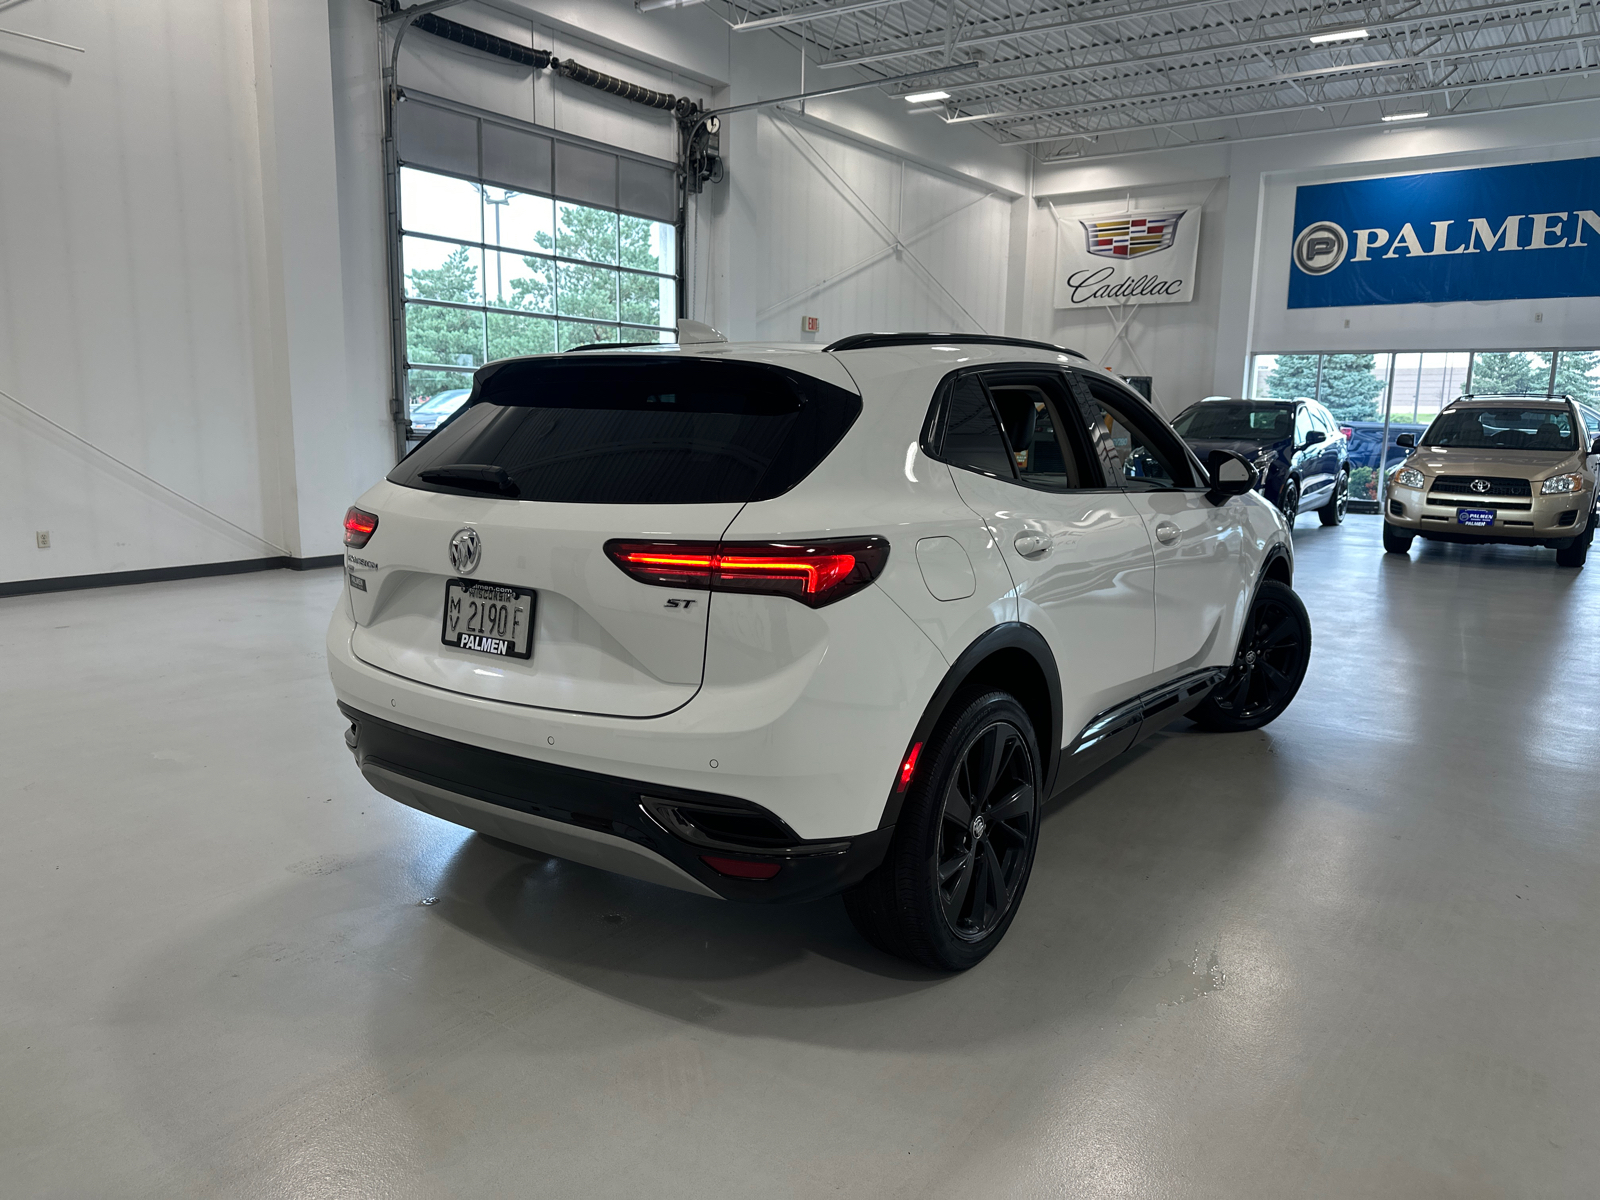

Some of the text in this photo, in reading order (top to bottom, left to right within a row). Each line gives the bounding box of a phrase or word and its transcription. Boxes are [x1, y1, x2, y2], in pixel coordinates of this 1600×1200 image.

[1350, 210, 1600, 262] PALMEN
[1067, 267, 1183, 303] Cadillac
[664, 598, 696, 609] ST
[460, 634, 508, 655] PALMEN
